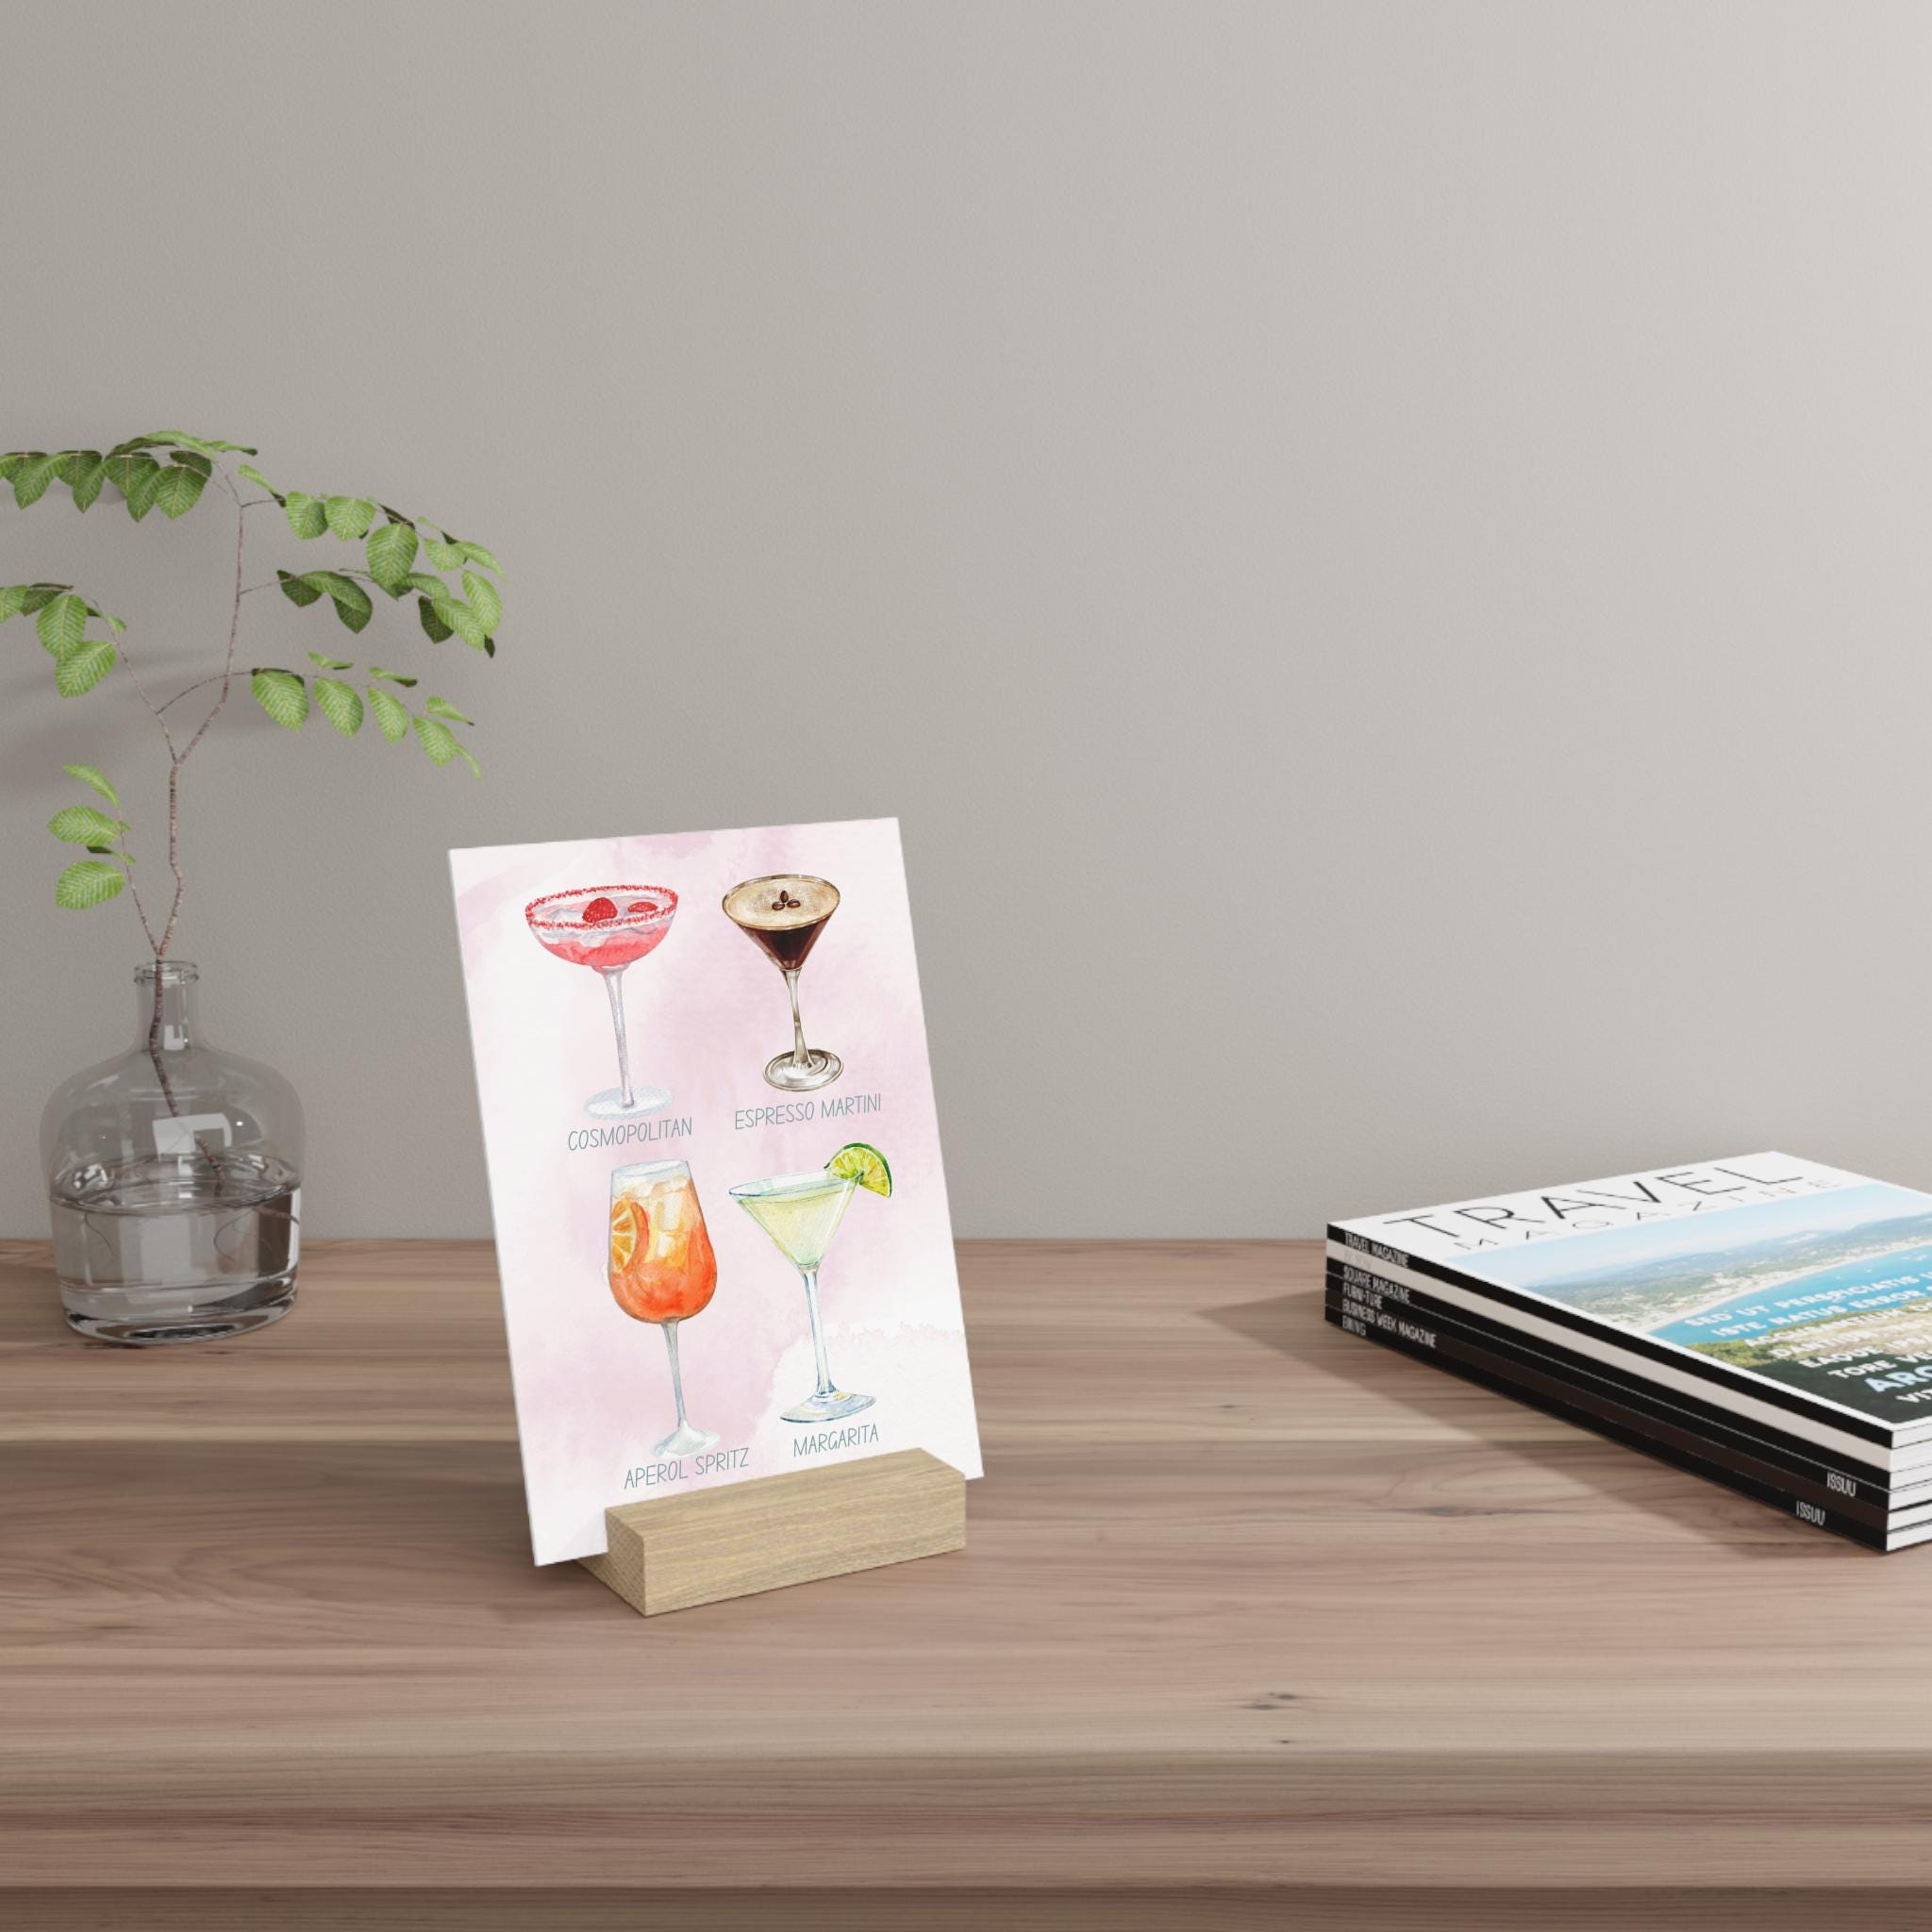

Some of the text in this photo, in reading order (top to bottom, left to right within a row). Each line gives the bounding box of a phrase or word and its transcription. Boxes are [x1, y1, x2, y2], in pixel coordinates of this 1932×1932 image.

[735, 1093, 882, 1130] ESPRESSO MARTINI
[568, 1117, 692, 1151] COSMOPOLITAN
[1383, 1167, 1803, 1239] TRAVEL
[1454, 1178, 1840, 1251] MAGAZINE
[1344, 1230, 1370, 1255] TRAVEL
[1371, 1241, 1408, 1268] MAGAZINE
[1343, 1265, 1410, 1304] SQUARE MAGAZINE
[1342, 1298, 1437, 1348] BUSINESS WEEK MAGAZINE
[1684, 1312, 1733, 1326] SED
[1736, 1305, 1771, 1317] UT
[1711, 1321, 1768, 1337] ISTE
[1768, 1304, 1847, 1325] NATUS
[1849, 1290, 1925, 1309] ERROR
[1798, 1346, 1883, 1369] EAQUE
[1827, 1351, 1932, 1379] TORE VE
[793, 1424, 879, 1457] MARGARITA
[624, 1447, 749, 1490] APEROL SPRITZ
[1826, 1471, 1857, 1497] ISSUU
[1796, 1500, 1825, 1525] ISSUU
